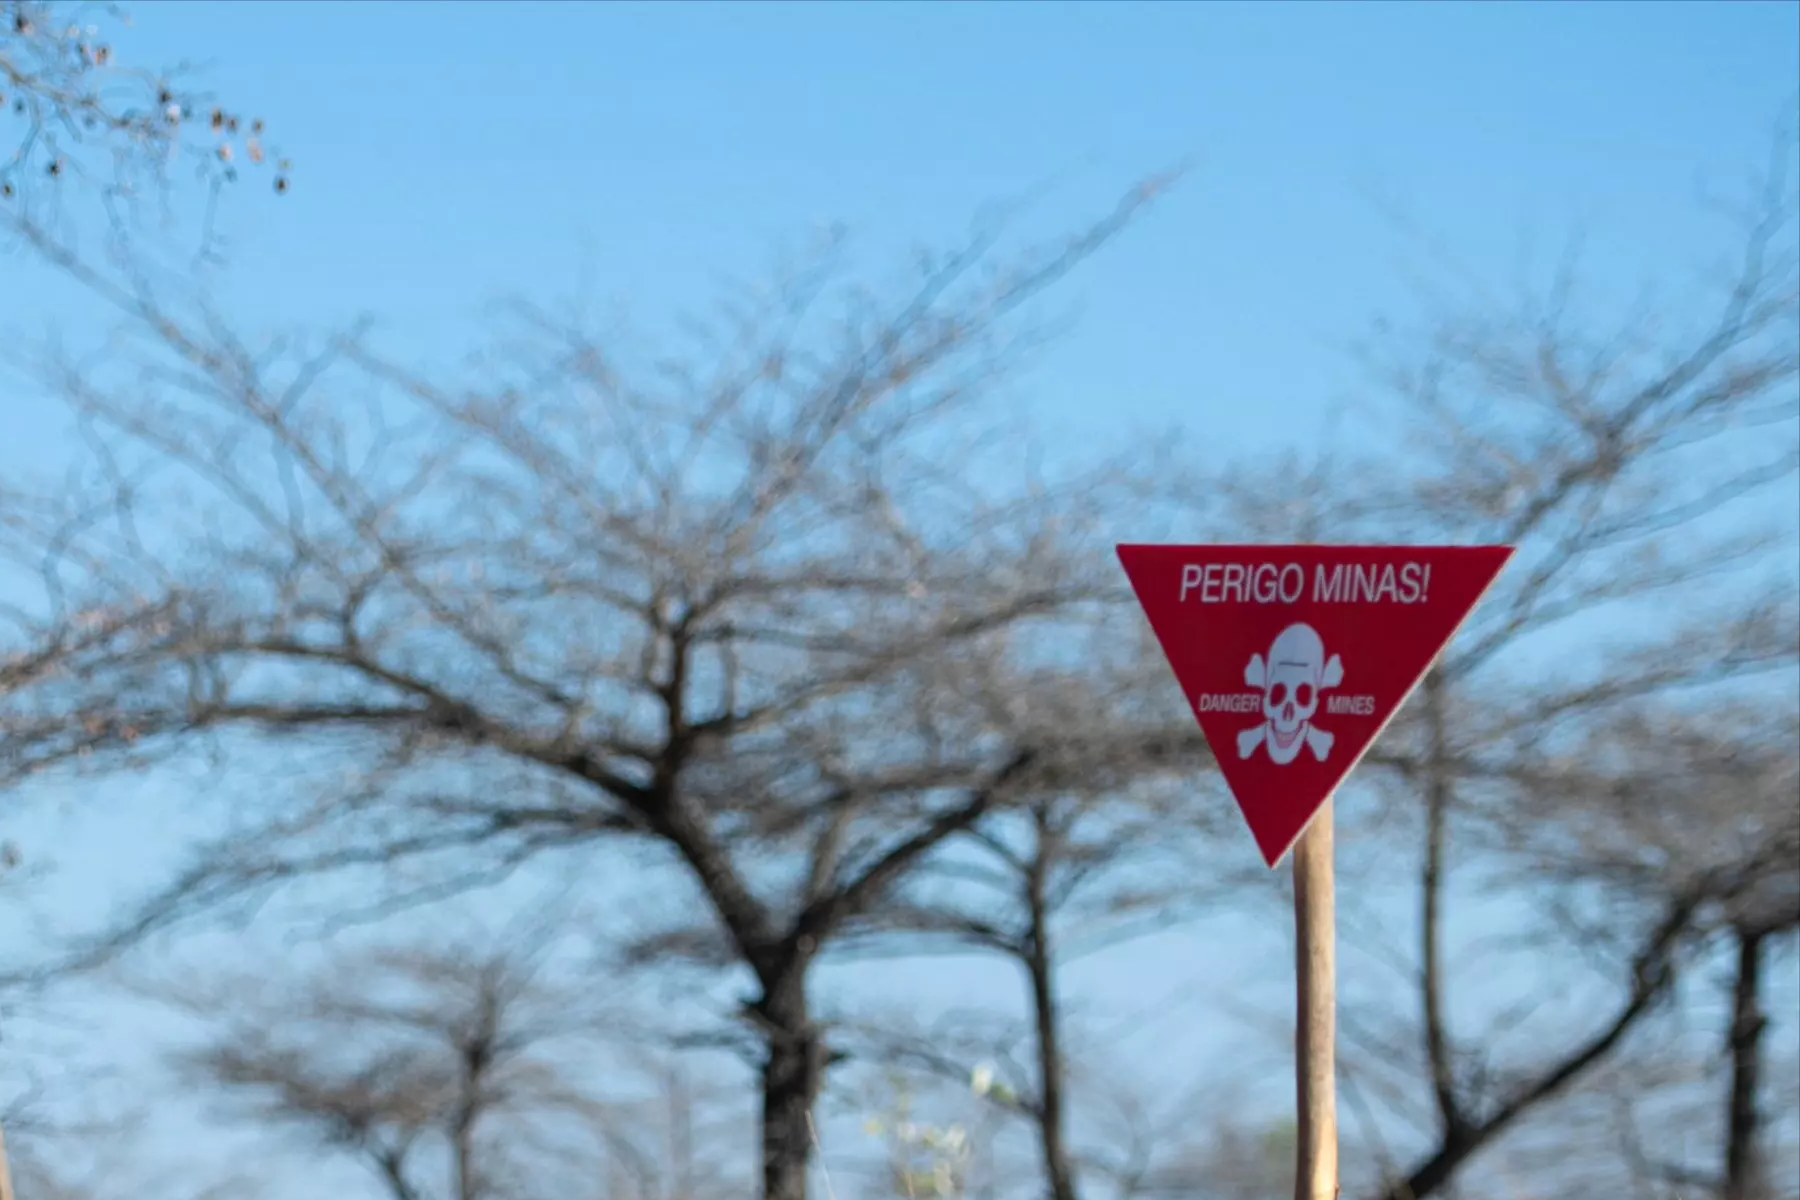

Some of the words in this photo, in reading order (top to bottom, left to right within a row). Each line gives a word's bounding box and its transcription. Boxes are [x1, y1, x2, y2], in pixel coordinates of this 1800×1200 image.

[1180, 562, 1304, 603] PERIGO
[1312, 562, 1431, 604] MINAS!
[1199, 693, 1261, 713] DANGER
[1326, 694, 1376, 715] MINES
